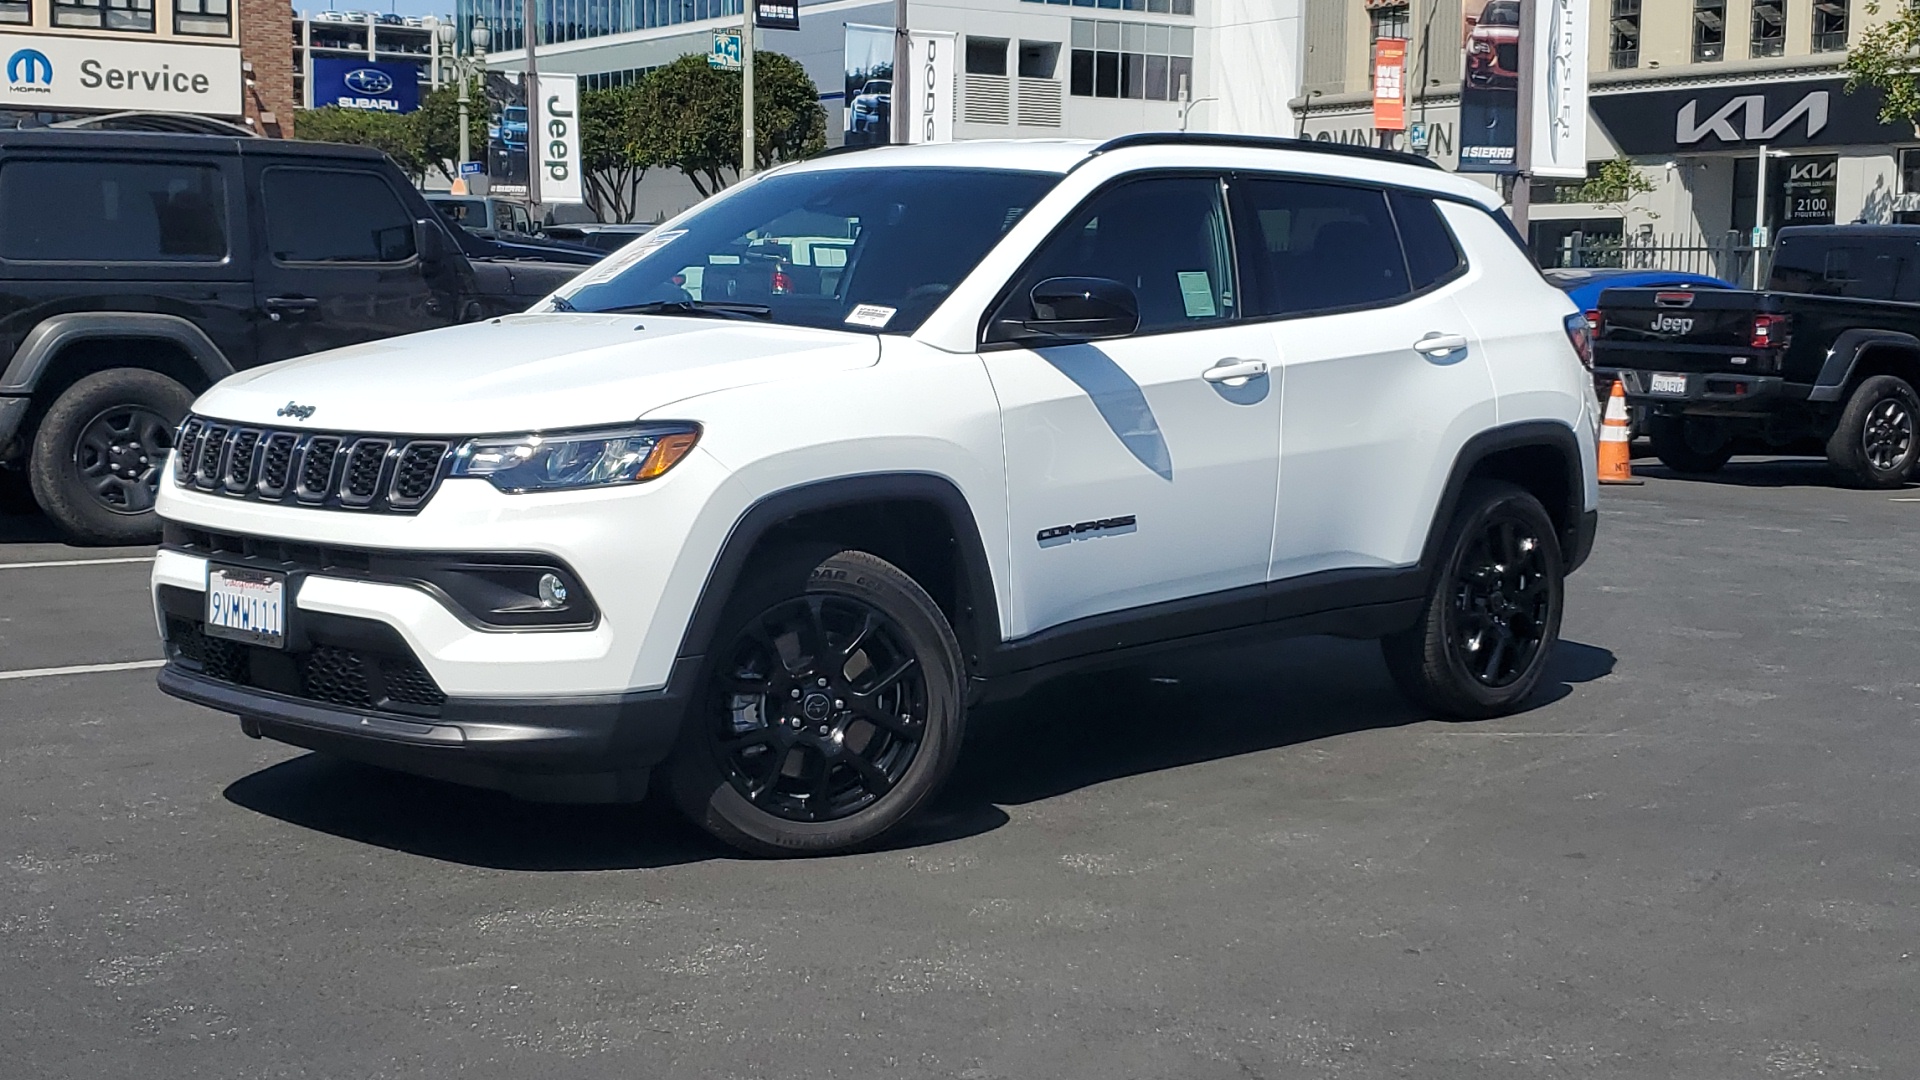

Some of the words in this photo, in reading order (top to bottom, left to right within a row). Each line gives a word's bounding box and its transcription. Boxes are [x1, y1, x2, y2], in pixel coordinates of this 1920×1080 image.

[80, 59, 210, 94] Service
[1561, 0, 1573, 138] HRYSLER
[339, 97, 398, 109] SUBARU
[1676, 91, 1829, 143] KIA
[544, 95, 573, 181] Jeep
[1470, 147, 1514, 158] SIERRA
[1790, 162, 1836, 179] KIA
[1797, 198, 1827, 211] 2100
[1651, 313, 1693, 335] Jeep
[277, 401, 316, 421] Jeep
[1037, 514, 1136, 541] COMPASS
[213, 592, 279, 635] 9VMW111
